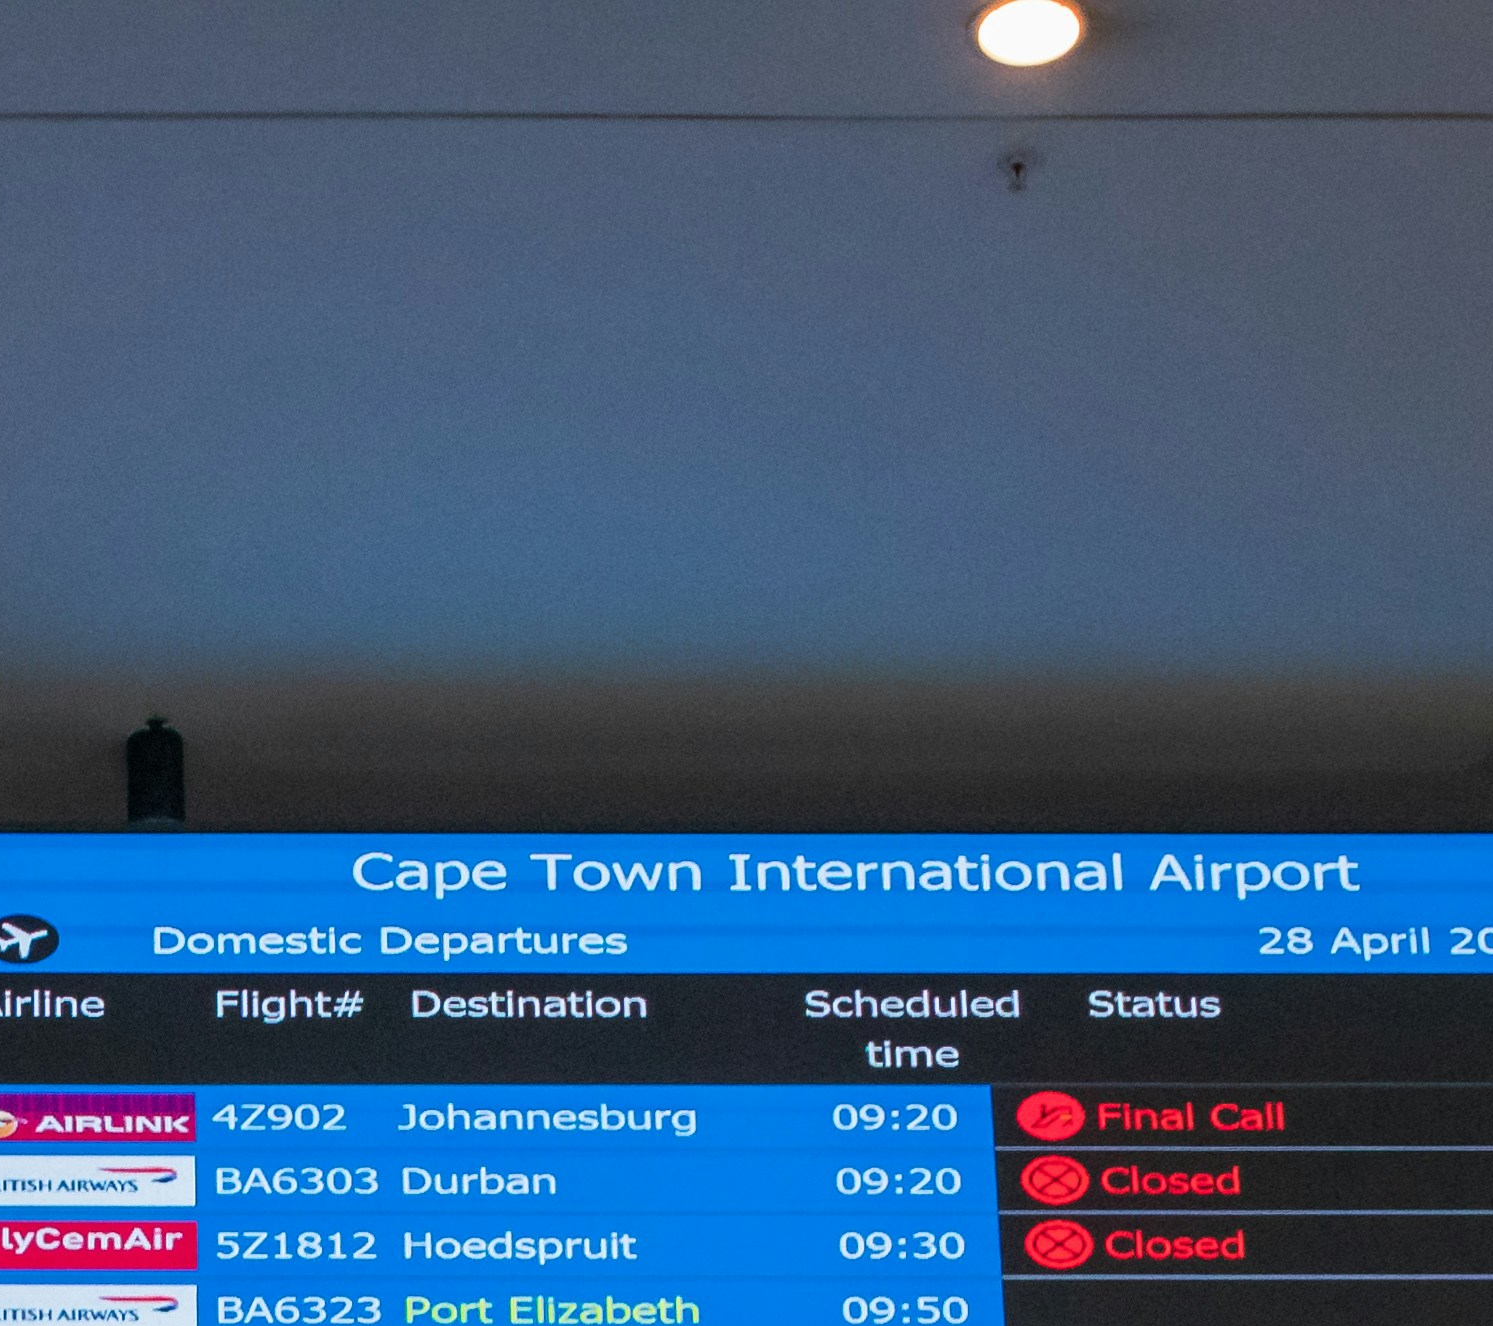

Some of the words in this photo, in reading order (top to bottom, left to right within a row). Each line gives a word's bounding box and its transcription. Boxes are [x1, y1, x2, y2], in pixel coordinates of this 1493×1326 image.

[353, 853, 506, 898] Cape
[530, 854, 701, 890] Town
[730, 853, 1122, 890] International
[1150, 855, 1359, 899] Airport
[154, 927, 361, 954] Domestic
[382, 927, 627, 960] Departures
[1260, 928, 1313, 954] 28
[1332, 928, 1429, 960] April
[36, 1116, 189, 1133] AIRLINK
[213, 1105, 345, 1129] 4Z902
[399, 1104, 696, 1136] Johannesburg
[834, 1105, 957, 1130] 09:20
[1098, 1102, 1194, 1130] Final
[1210, 1102, 1285, 1130] Call
[218, 1232, 376, 1258] 5Z1812
[405, 1232, 636, 1264] Hoedspruit
[840, 1232, 964, 1258] 09:30
[1105, 1230, 1245, 1260] Closed
